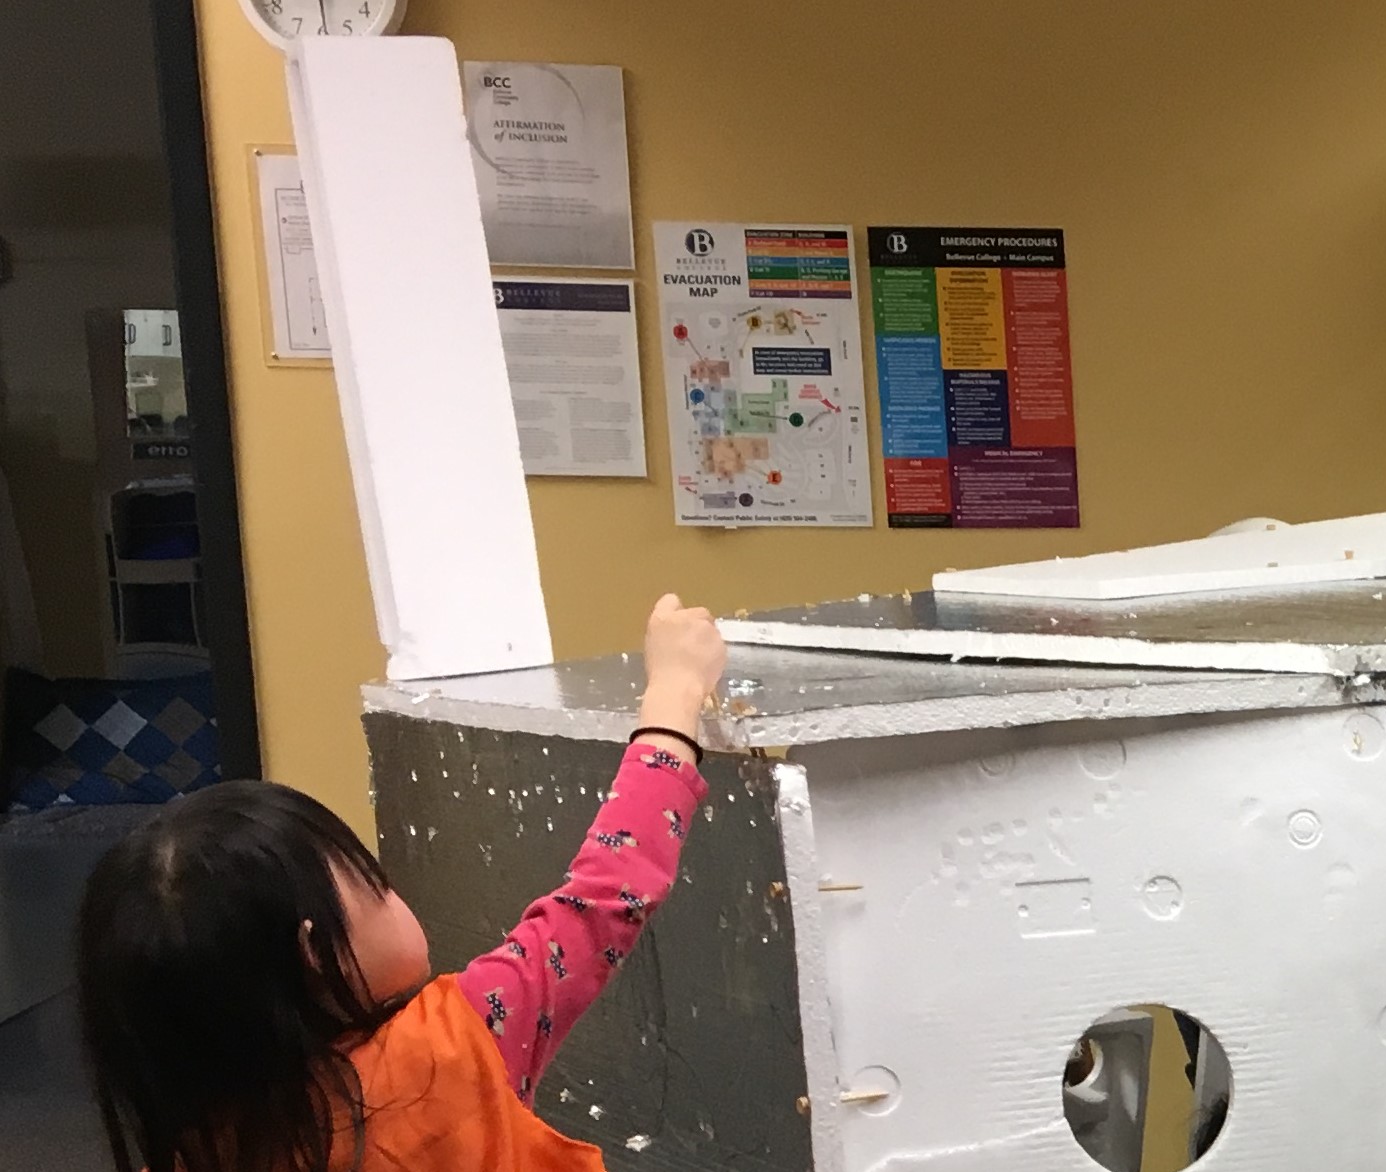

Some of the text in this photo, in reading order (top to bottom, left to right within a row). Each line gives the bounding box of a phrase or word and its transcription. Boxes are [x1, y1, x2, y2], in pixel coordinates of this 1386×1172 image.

[358, 1, 370, 18] 4
[291, 17, 303, 35] 7
[342, 19, 353, 36] 5
[483, 76, 512, 89] BCC
[493, 119, 566, 131] AFFIRMATION
[494, 130, 568, 143] of INCLUSION
[692, 231, 715, 256] B
[892, 234, 908, 253] B
[940, 236, 1058, 247] EMERGENCY PROCEDURES
[663, 274, 742, 285] EVACUATION
[688, 287, 719, 298] MAP
